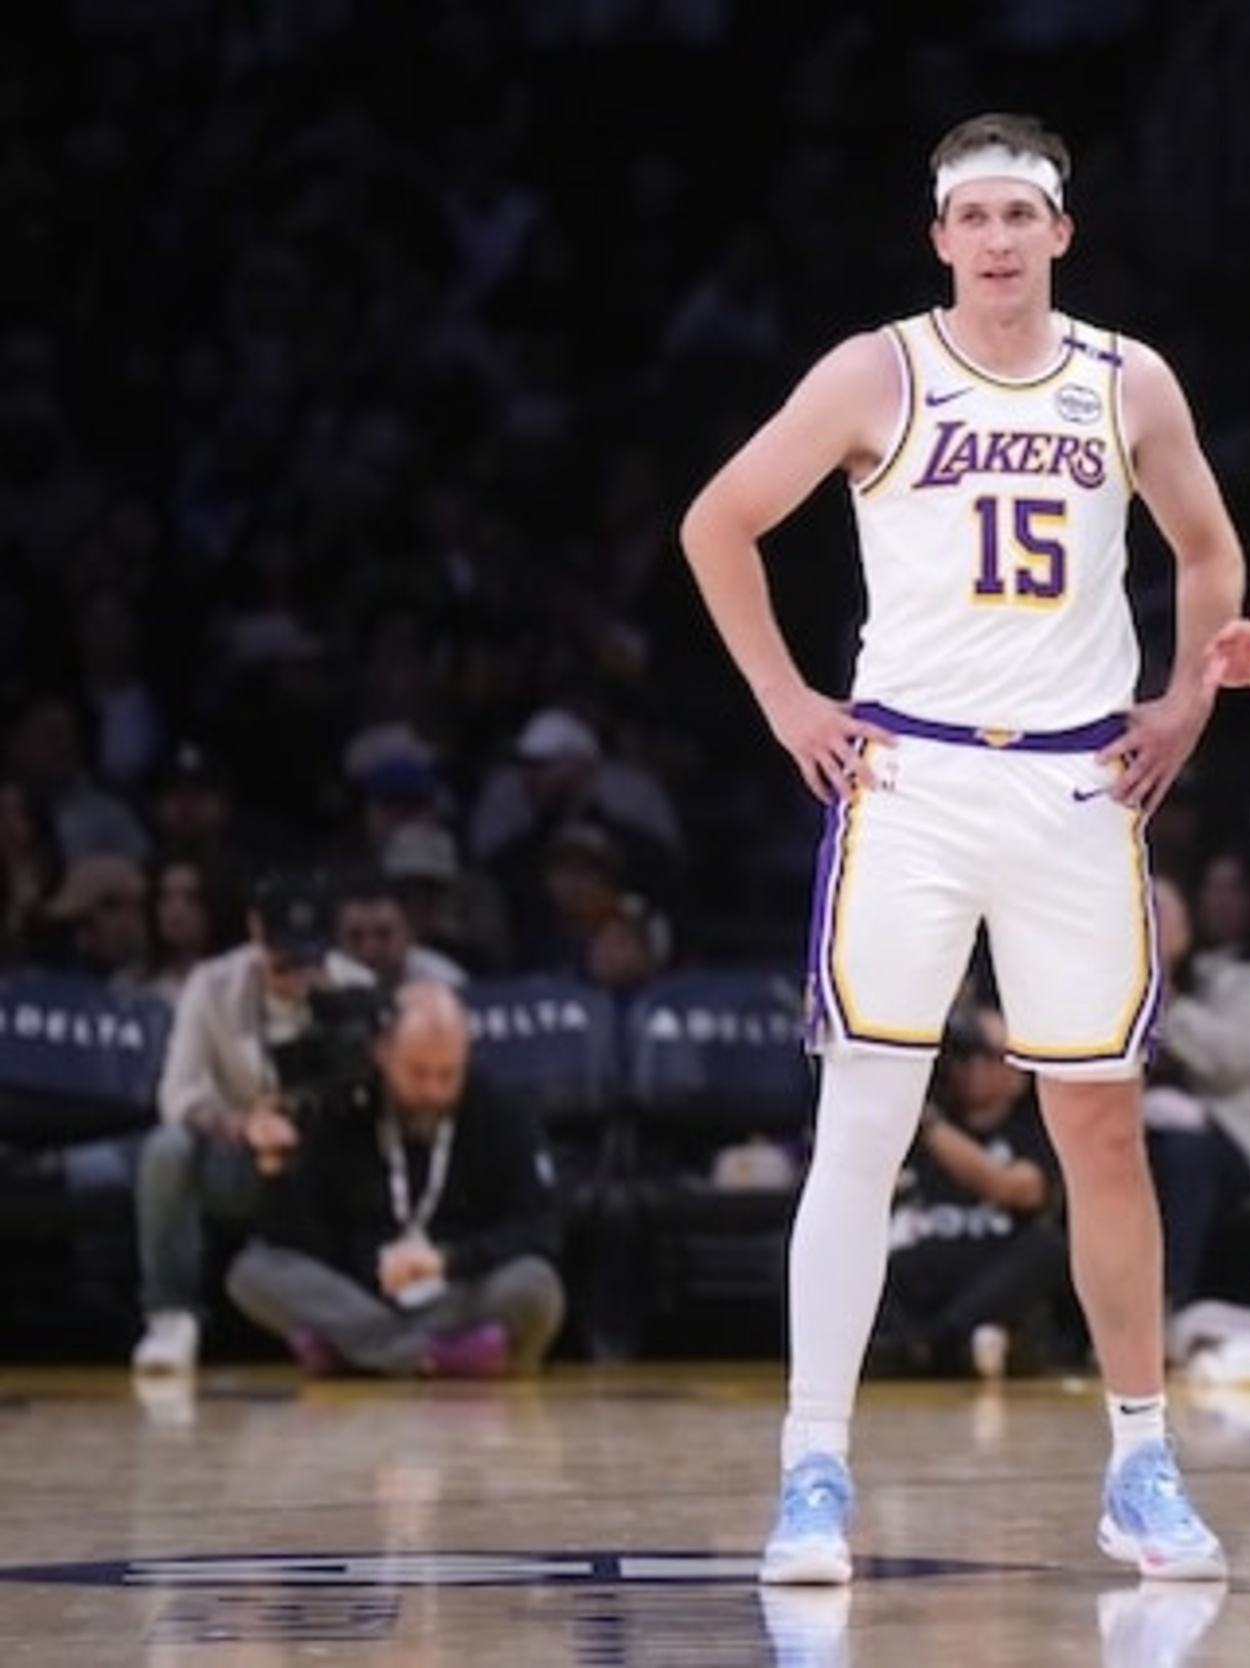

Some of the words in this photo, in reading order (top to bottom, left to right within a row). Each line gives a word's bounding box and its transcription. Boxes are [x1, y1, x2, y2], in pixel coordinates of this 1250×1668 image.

[912, 421, 1106, 489] LAKERS
[973, 496, 1066, 602] 15
[14, 1003, 144, 1049] DELTA
